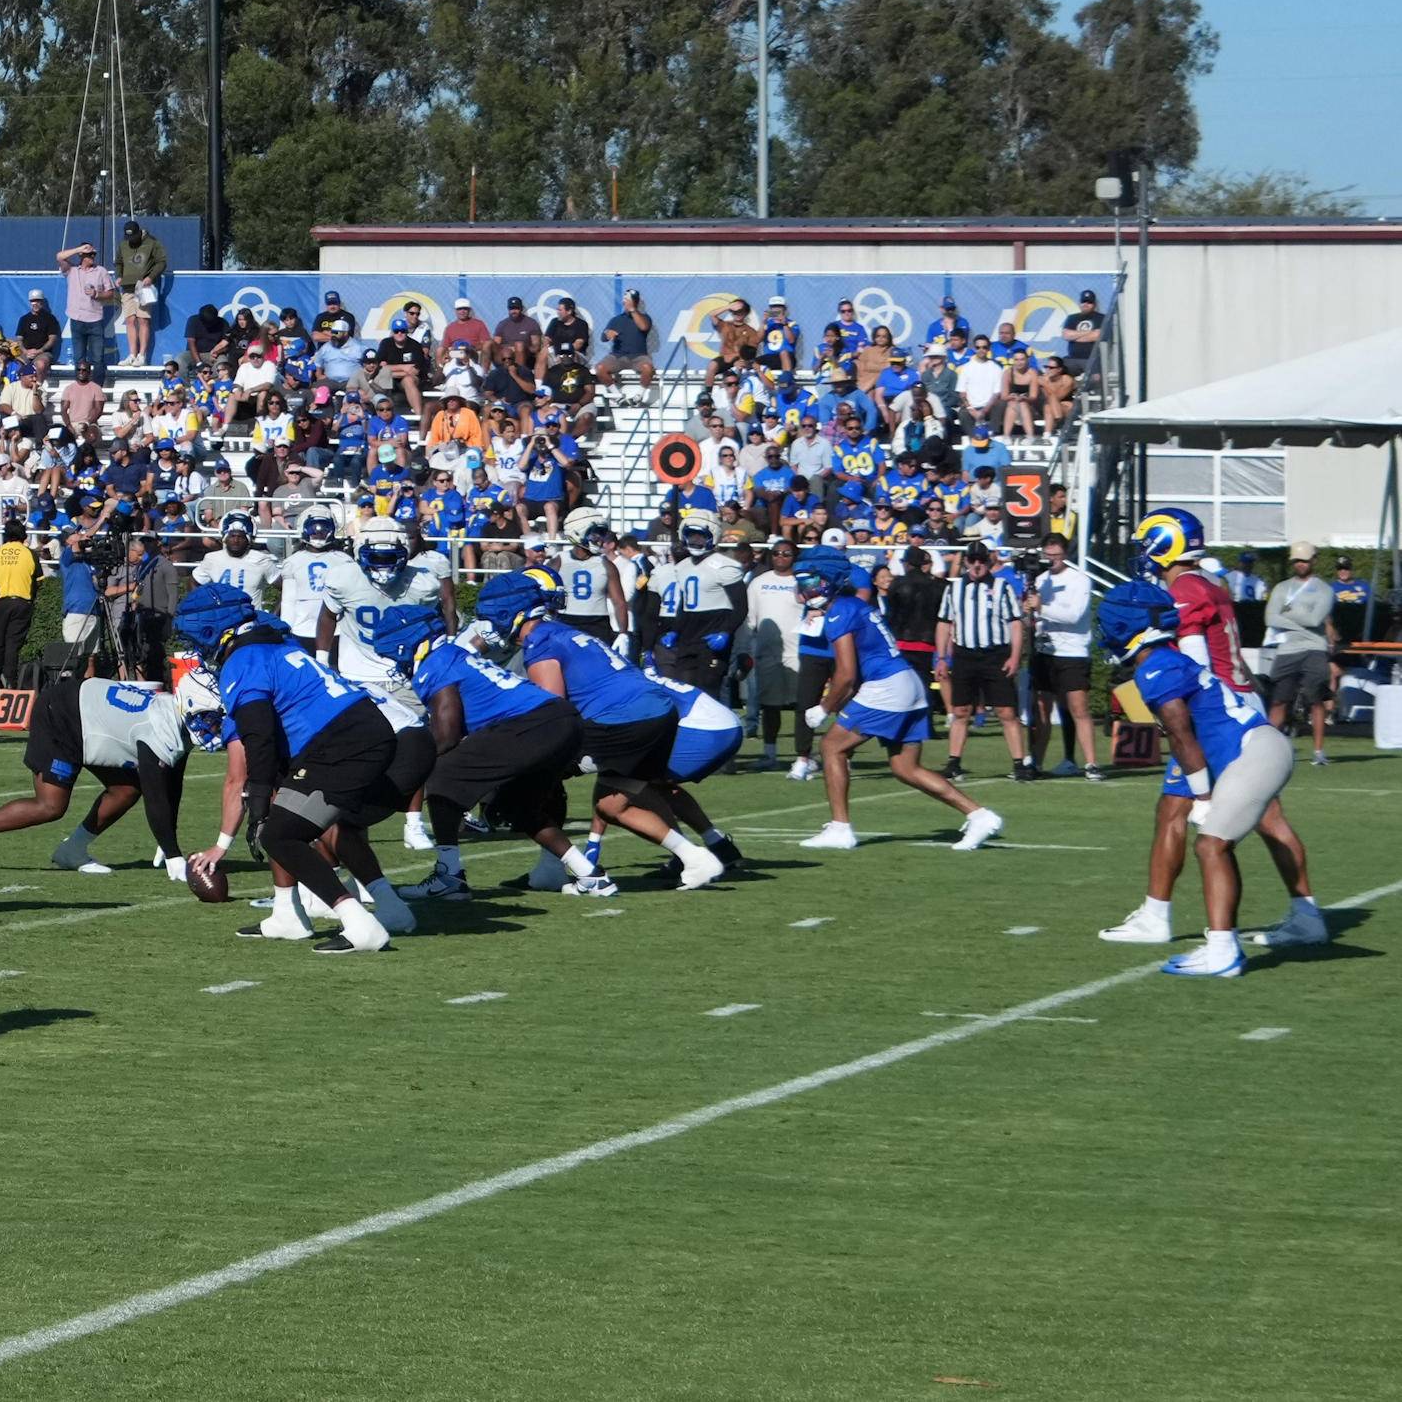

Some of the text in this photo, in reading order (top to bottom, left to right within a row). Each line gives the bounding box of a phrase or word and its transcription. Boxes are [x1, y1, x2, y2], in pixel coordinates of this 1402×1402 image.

[1006, 474, 1043, 517] 3
[1, 548, 21, 556] CSC
[572, 570, 592, 600] 8
[1114, 724, 1154, 760] 20
